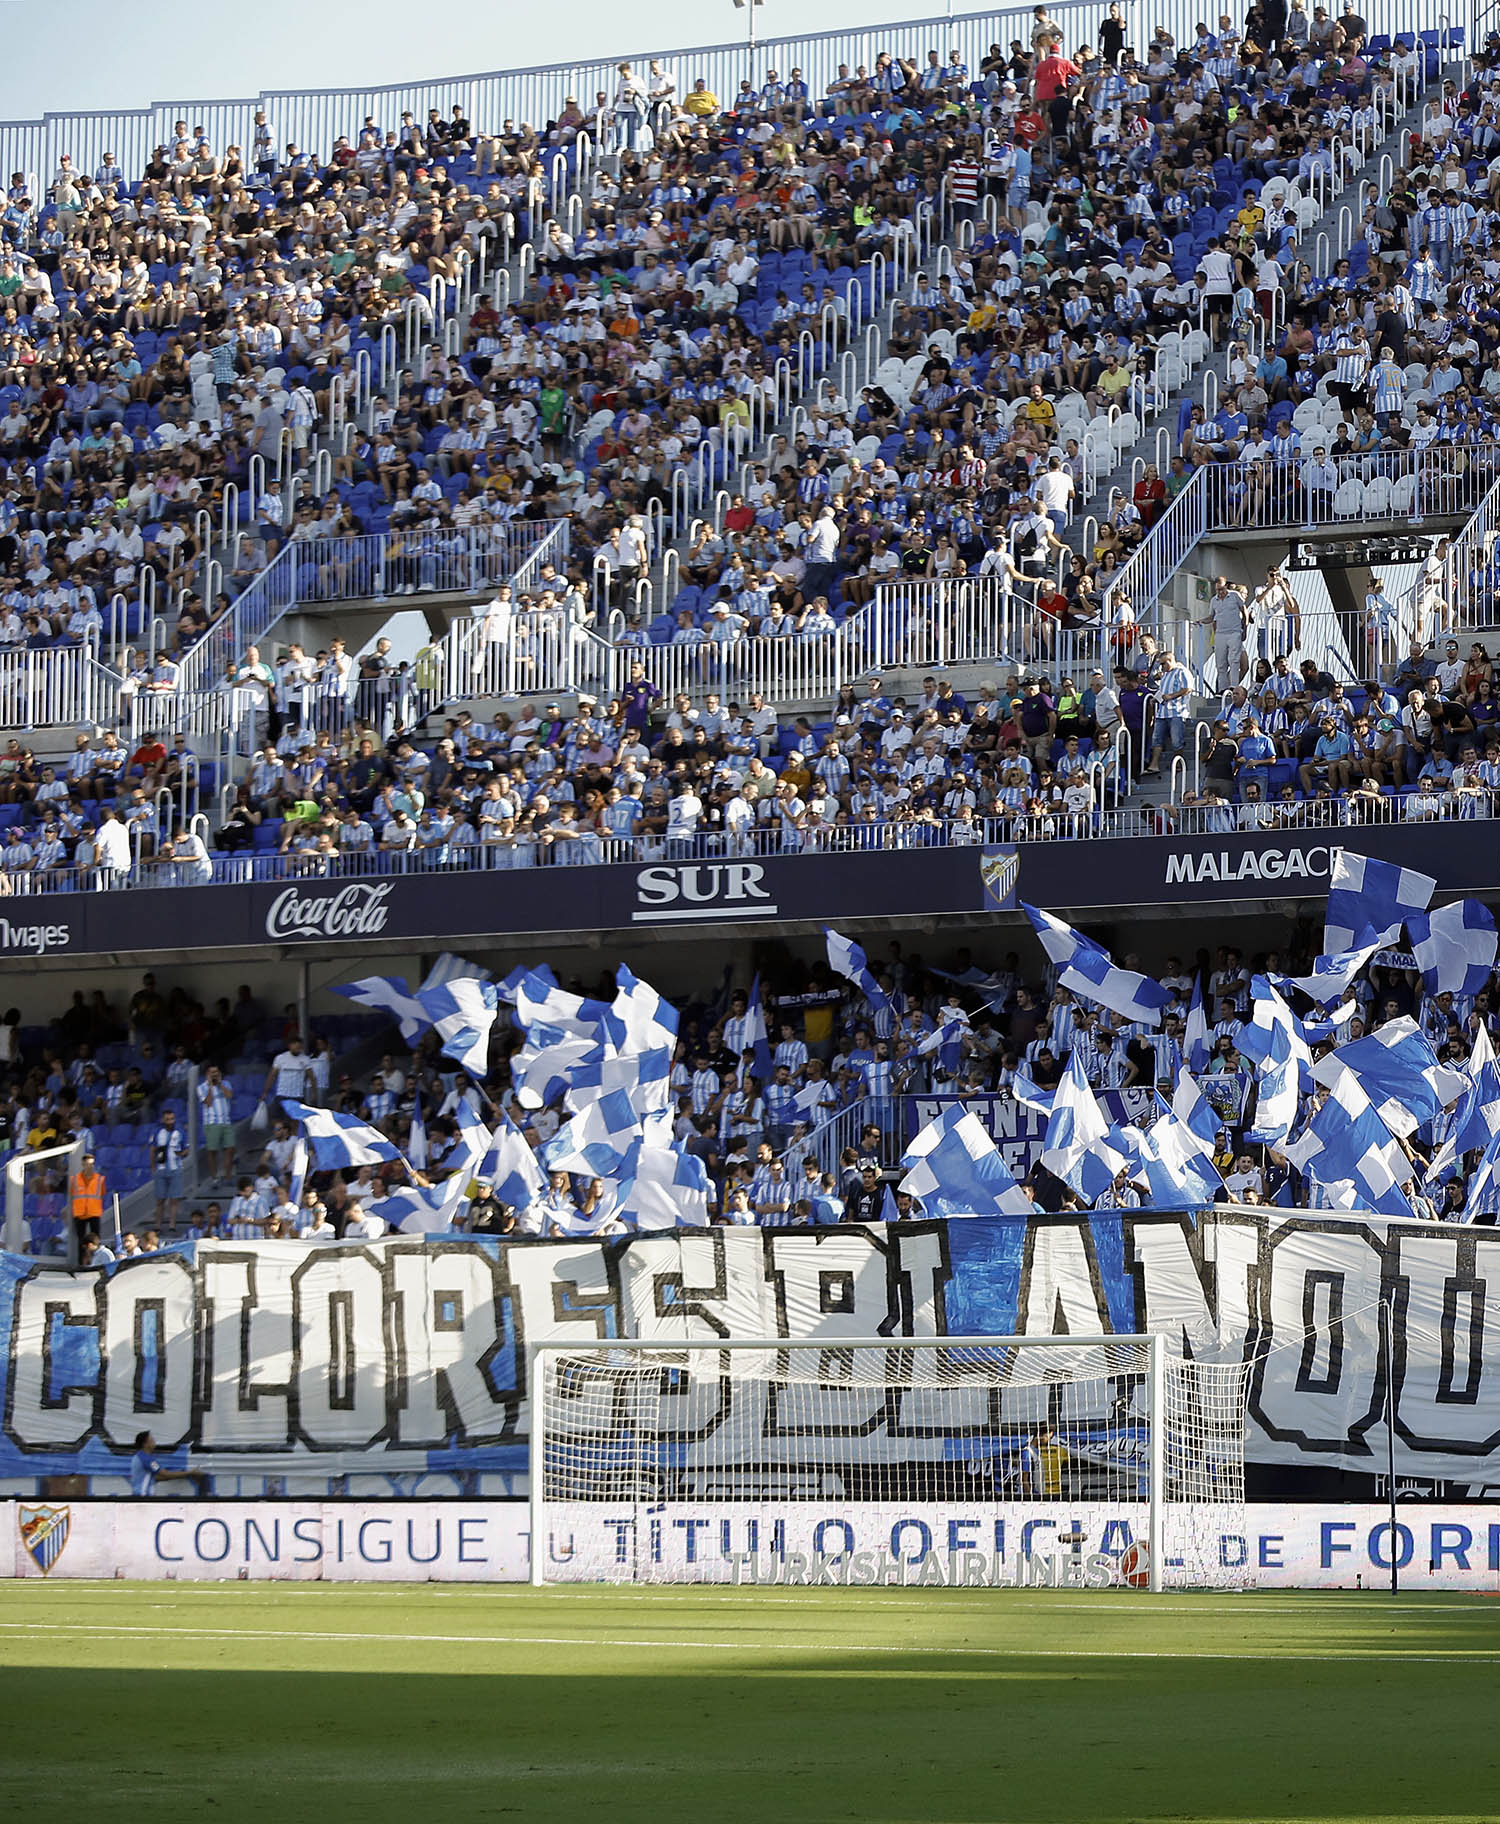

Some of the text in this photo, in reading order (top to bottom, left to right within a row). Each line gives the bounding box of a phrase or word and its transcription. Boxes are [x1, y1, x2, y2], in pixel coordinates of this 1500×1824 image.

[615, 810, 629, 828] 17
[673, 807, 682, 825] 2
[636, 864, 770, 904] SUR
[265, 881, 397, 938] Coca-Cola
[5, 1225, 733, 1453] COLORES
[155, 1517, 489, 1564] CONSIGUE
[603, 1502, 856, 1566] TÍTULO
[889, 1518, 1184, 1568] OFICIA
[1218, 1534, 1284, 1568] DE
[723, 1550, 1112, 1589] TURKISH AIRLINES
